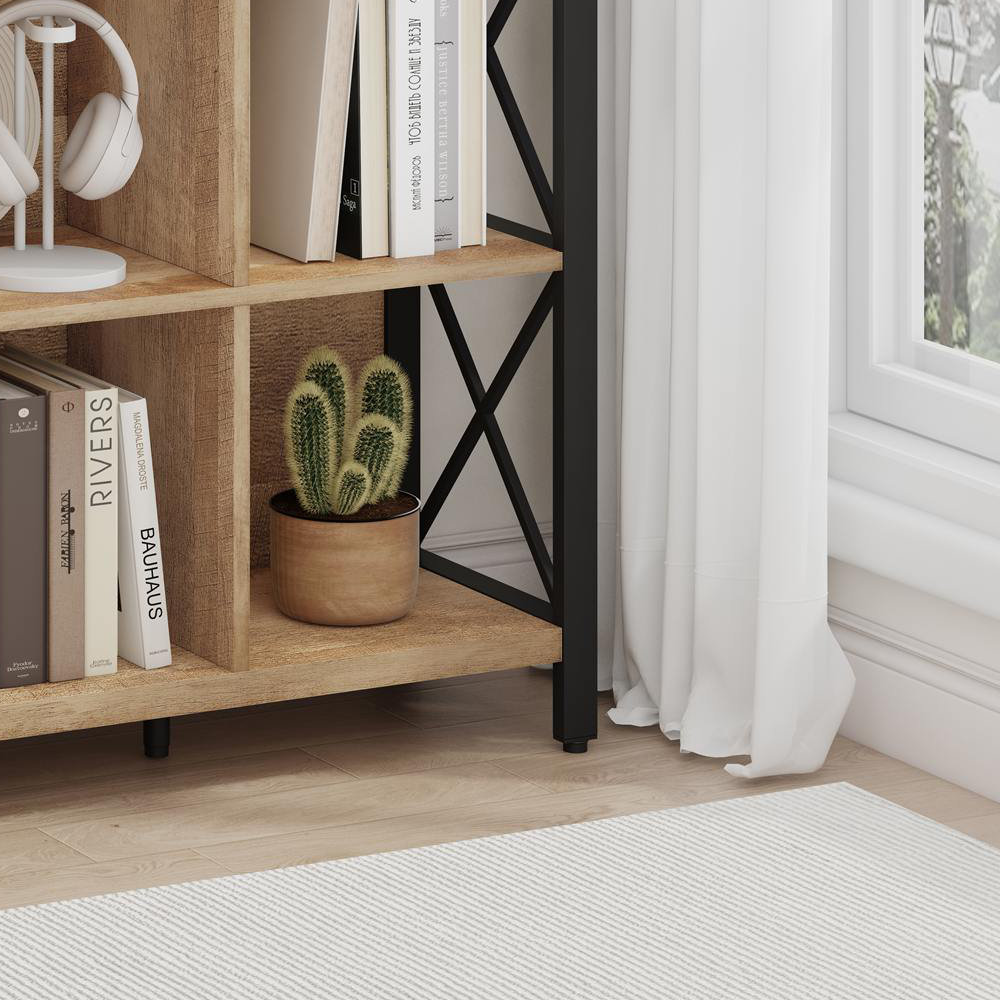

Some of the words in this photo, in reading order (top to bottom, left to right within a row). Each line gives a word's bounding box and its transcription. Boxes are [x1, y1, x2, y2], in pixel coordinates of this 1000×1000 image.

[408, 17, 422, 46] ЗВЕЗДУ
[408, 92, 422, 120] ВИДЕТЬ
[408, 121, 422, 146] ЧТОБ
[133, 411, 145, 459] MAGDALENA
[90, 397, 113, 507] RIVERS
[137, 459, 149, 491] DROSTE
[140, 527, 164, 620] BAUHAUS
